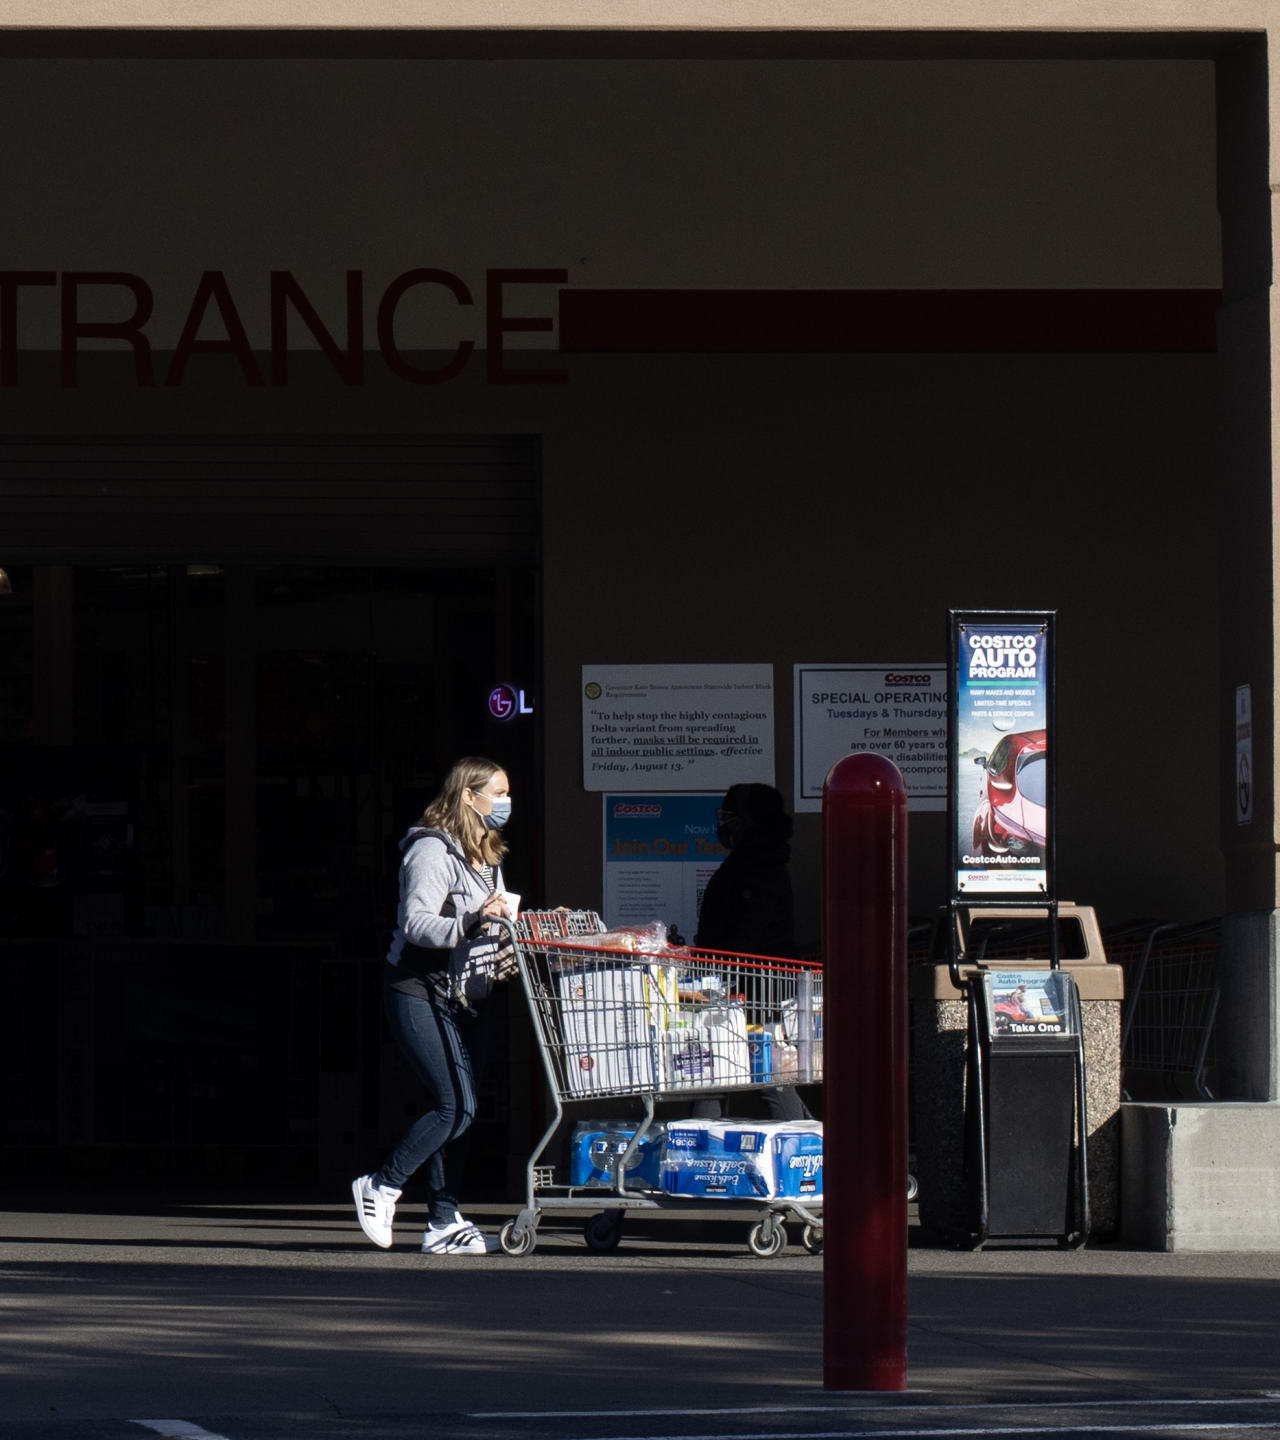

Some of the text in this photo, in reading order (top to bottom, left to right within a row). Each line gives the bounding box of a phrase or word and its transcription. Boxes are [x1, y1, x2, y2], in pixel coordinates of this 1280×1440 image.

[969, 635, 1036, 649] COSTCO
[970, 648, 1037, 667] AUTO
[884, 673, 931, 682] COSTCO
[969, 667, 1036, 678] PROGRAM
[811, 693, 870, 704] SPECIAL
[612, 712, 634, 722] help
[636, 712, 658, 722] stop
[660, 712, 677, 720] the
[679, 712, 709, 722] highly
[712, 711, 767, 721] contagious
[827, 709, 878, 720] Tuesdays
[881, 709, 889, 718] &
[591, 723, 736, 735] Delta variant from spreading
[864, 728, 947, 737] For Members wh
[633, 735, 664, 745] masks
[667, 735, 685, 745] will
[688, 736, 700, 745] be
[702, 735, 746, 745] required
[749, 735, 759, 745] in
[894, 740, 906, 749] 60
[908, 742, 935, 751] years
[591, 747, 604, 757] all
[606, 747, 640, 757] indoor
[642, 747, 673, 757] public
[720, 747, 763, 757] effective
[631, 762, 668, 772] August
[615, 804, 661, 813] COSTCO
[684, 824, 709, 835] Now
[612, 838, 649, 855] Join
[654, 838, 689, 854] Our
[962, 855, 1040, 864] CostcoAuto.com
[1010, 1023, 1061, 1032] Take One
